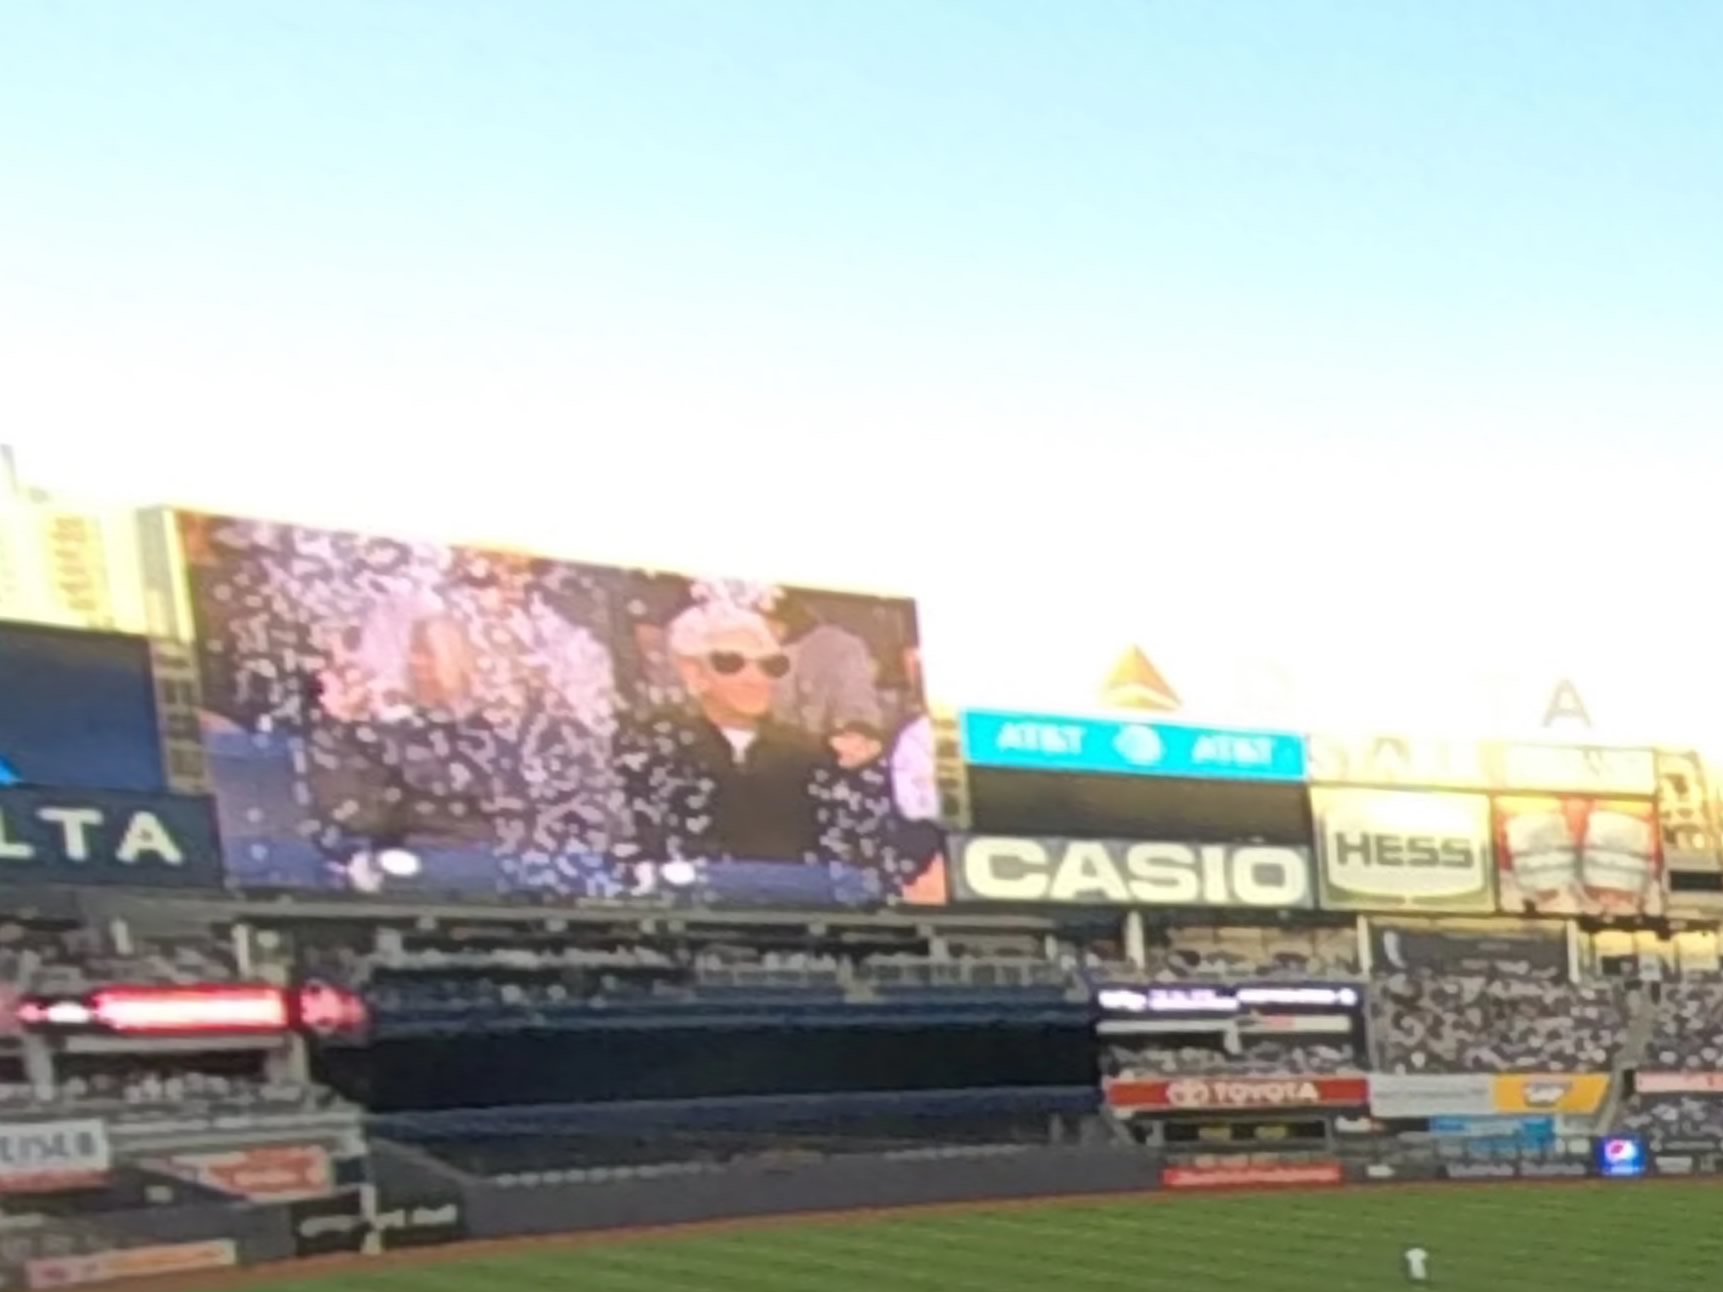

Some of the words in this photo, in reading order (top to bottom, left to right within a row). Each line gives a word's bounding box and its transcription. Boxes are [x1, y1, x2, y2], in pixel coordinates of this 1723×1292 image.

[1335, 831, 1475, 869] HESS
[964, 836, 1308, 906] CASIO
[1213, 1081, 1320, 1103] TOYOTA
